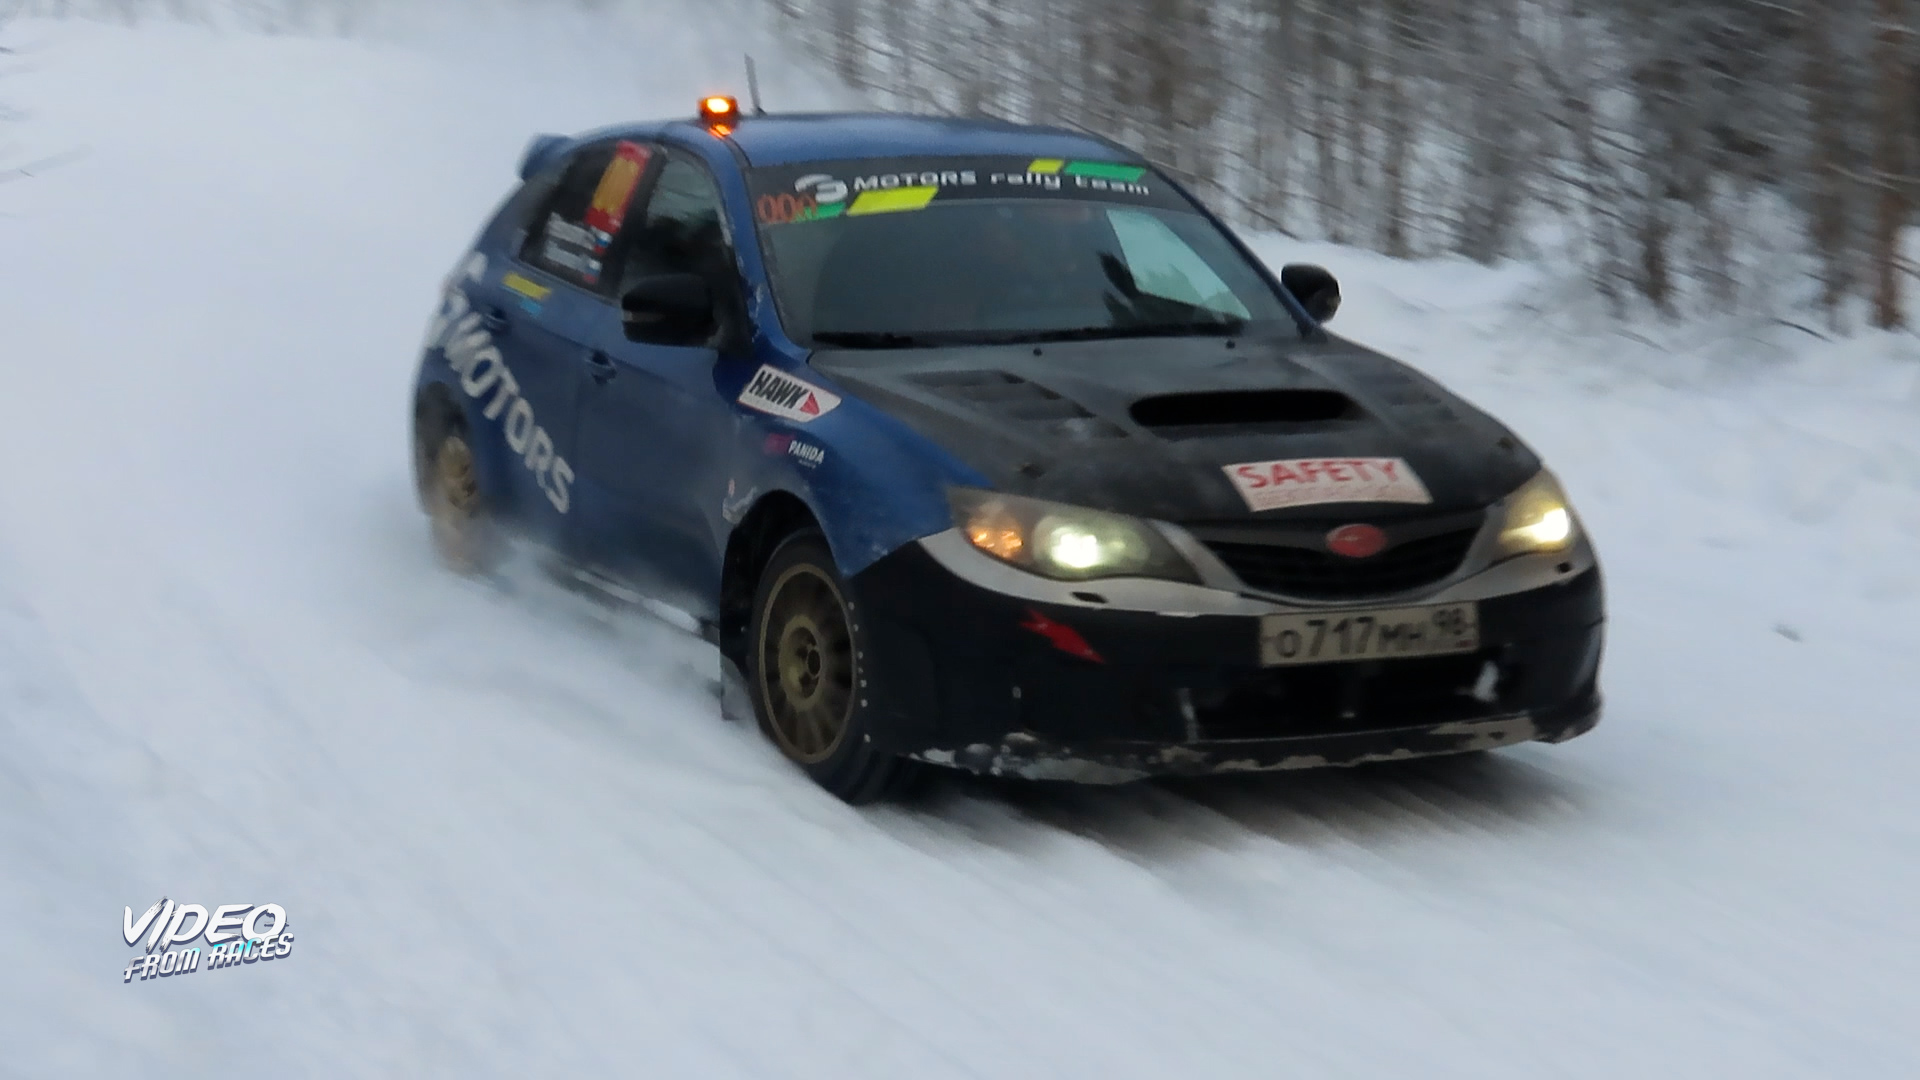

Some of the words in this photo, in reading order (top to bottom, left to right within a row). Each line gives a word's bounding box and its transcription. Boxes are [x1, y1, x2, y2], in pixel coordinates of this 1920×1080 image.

[854, 170, 976, 191] MOTORS
[990, 172, 1061, 190] rally
[1075, 174, 1149, 195] team
[749, 370, 809, 410] HAWK
[443, 312, 575, 514] MOTORS
[788, 440, 825, 464] PANIDA
[1237, 460, 1397, 489] SAFETY
